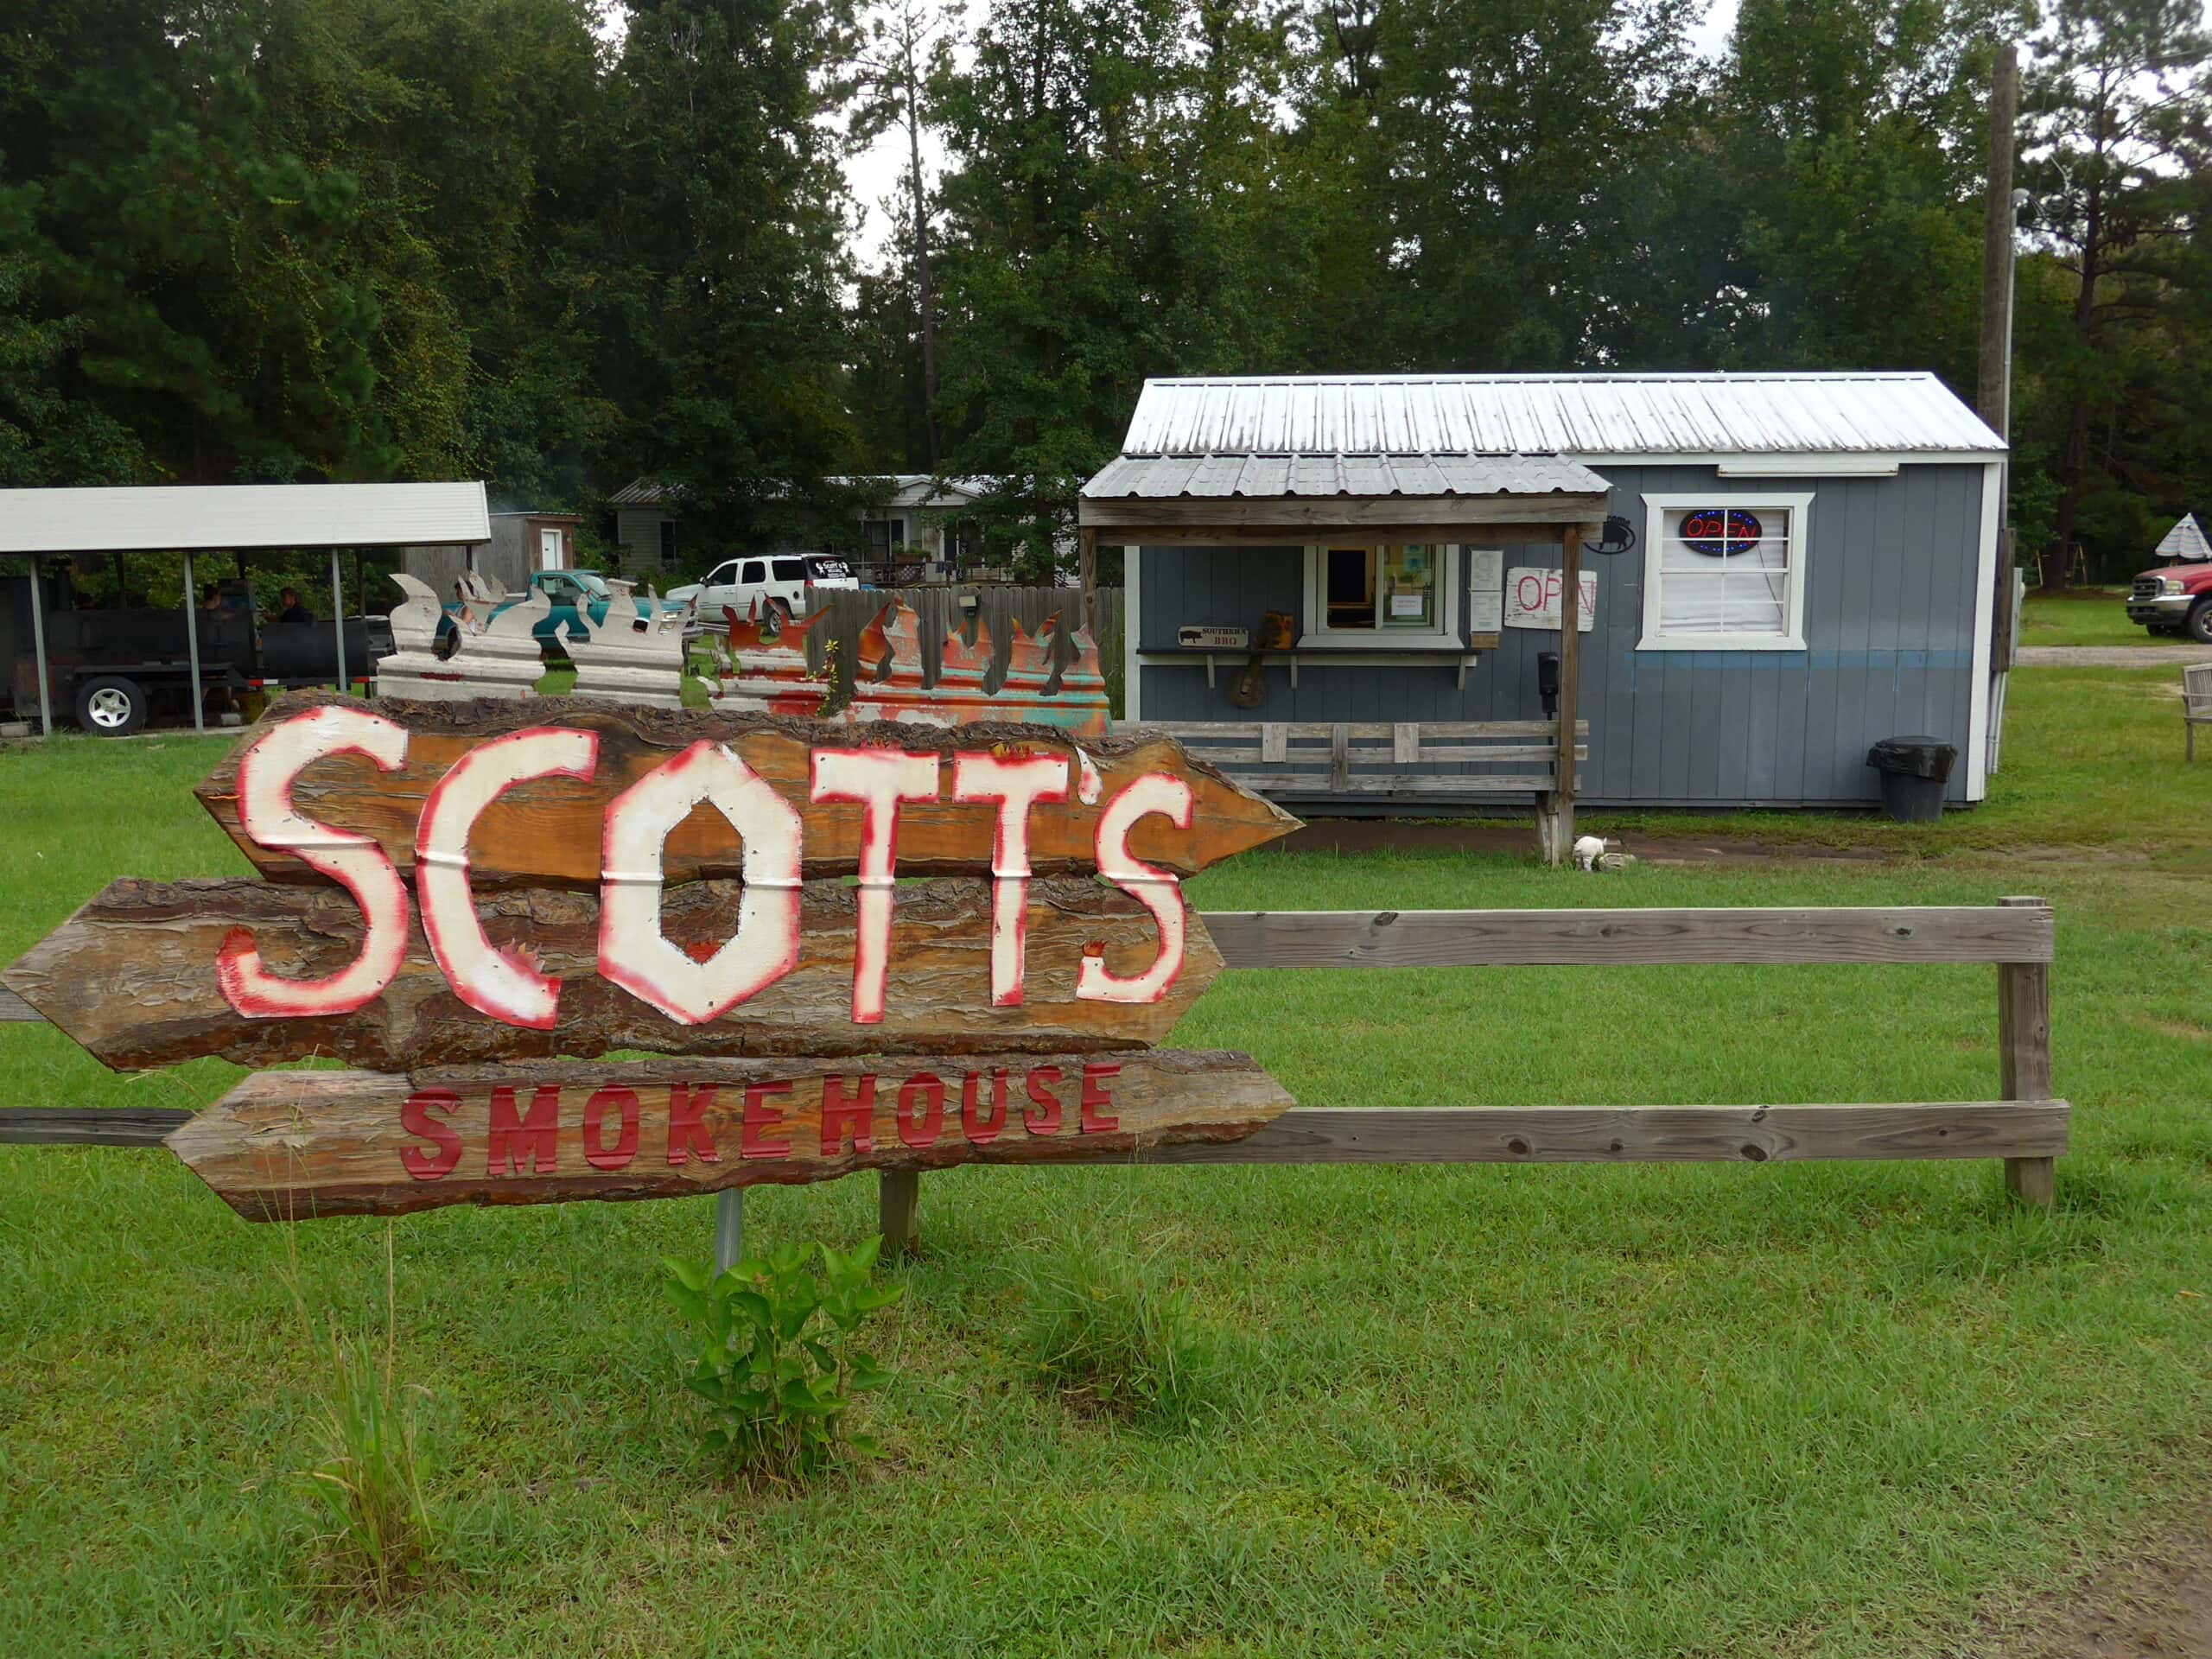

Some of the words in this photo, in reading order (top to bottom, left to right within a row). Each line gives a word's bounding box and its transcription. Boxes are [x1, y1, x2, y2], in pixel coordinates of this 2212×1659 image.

[1687, 518, 1757, 544] OPEN
[1517, 575, 1597, 614] OPN
[1214, 636, 1237, 645] BBQ
[217, 705, 1193, 1029] SCOTT'S
[399, 1062, 1121, 1180] SMOKEHOUSE
